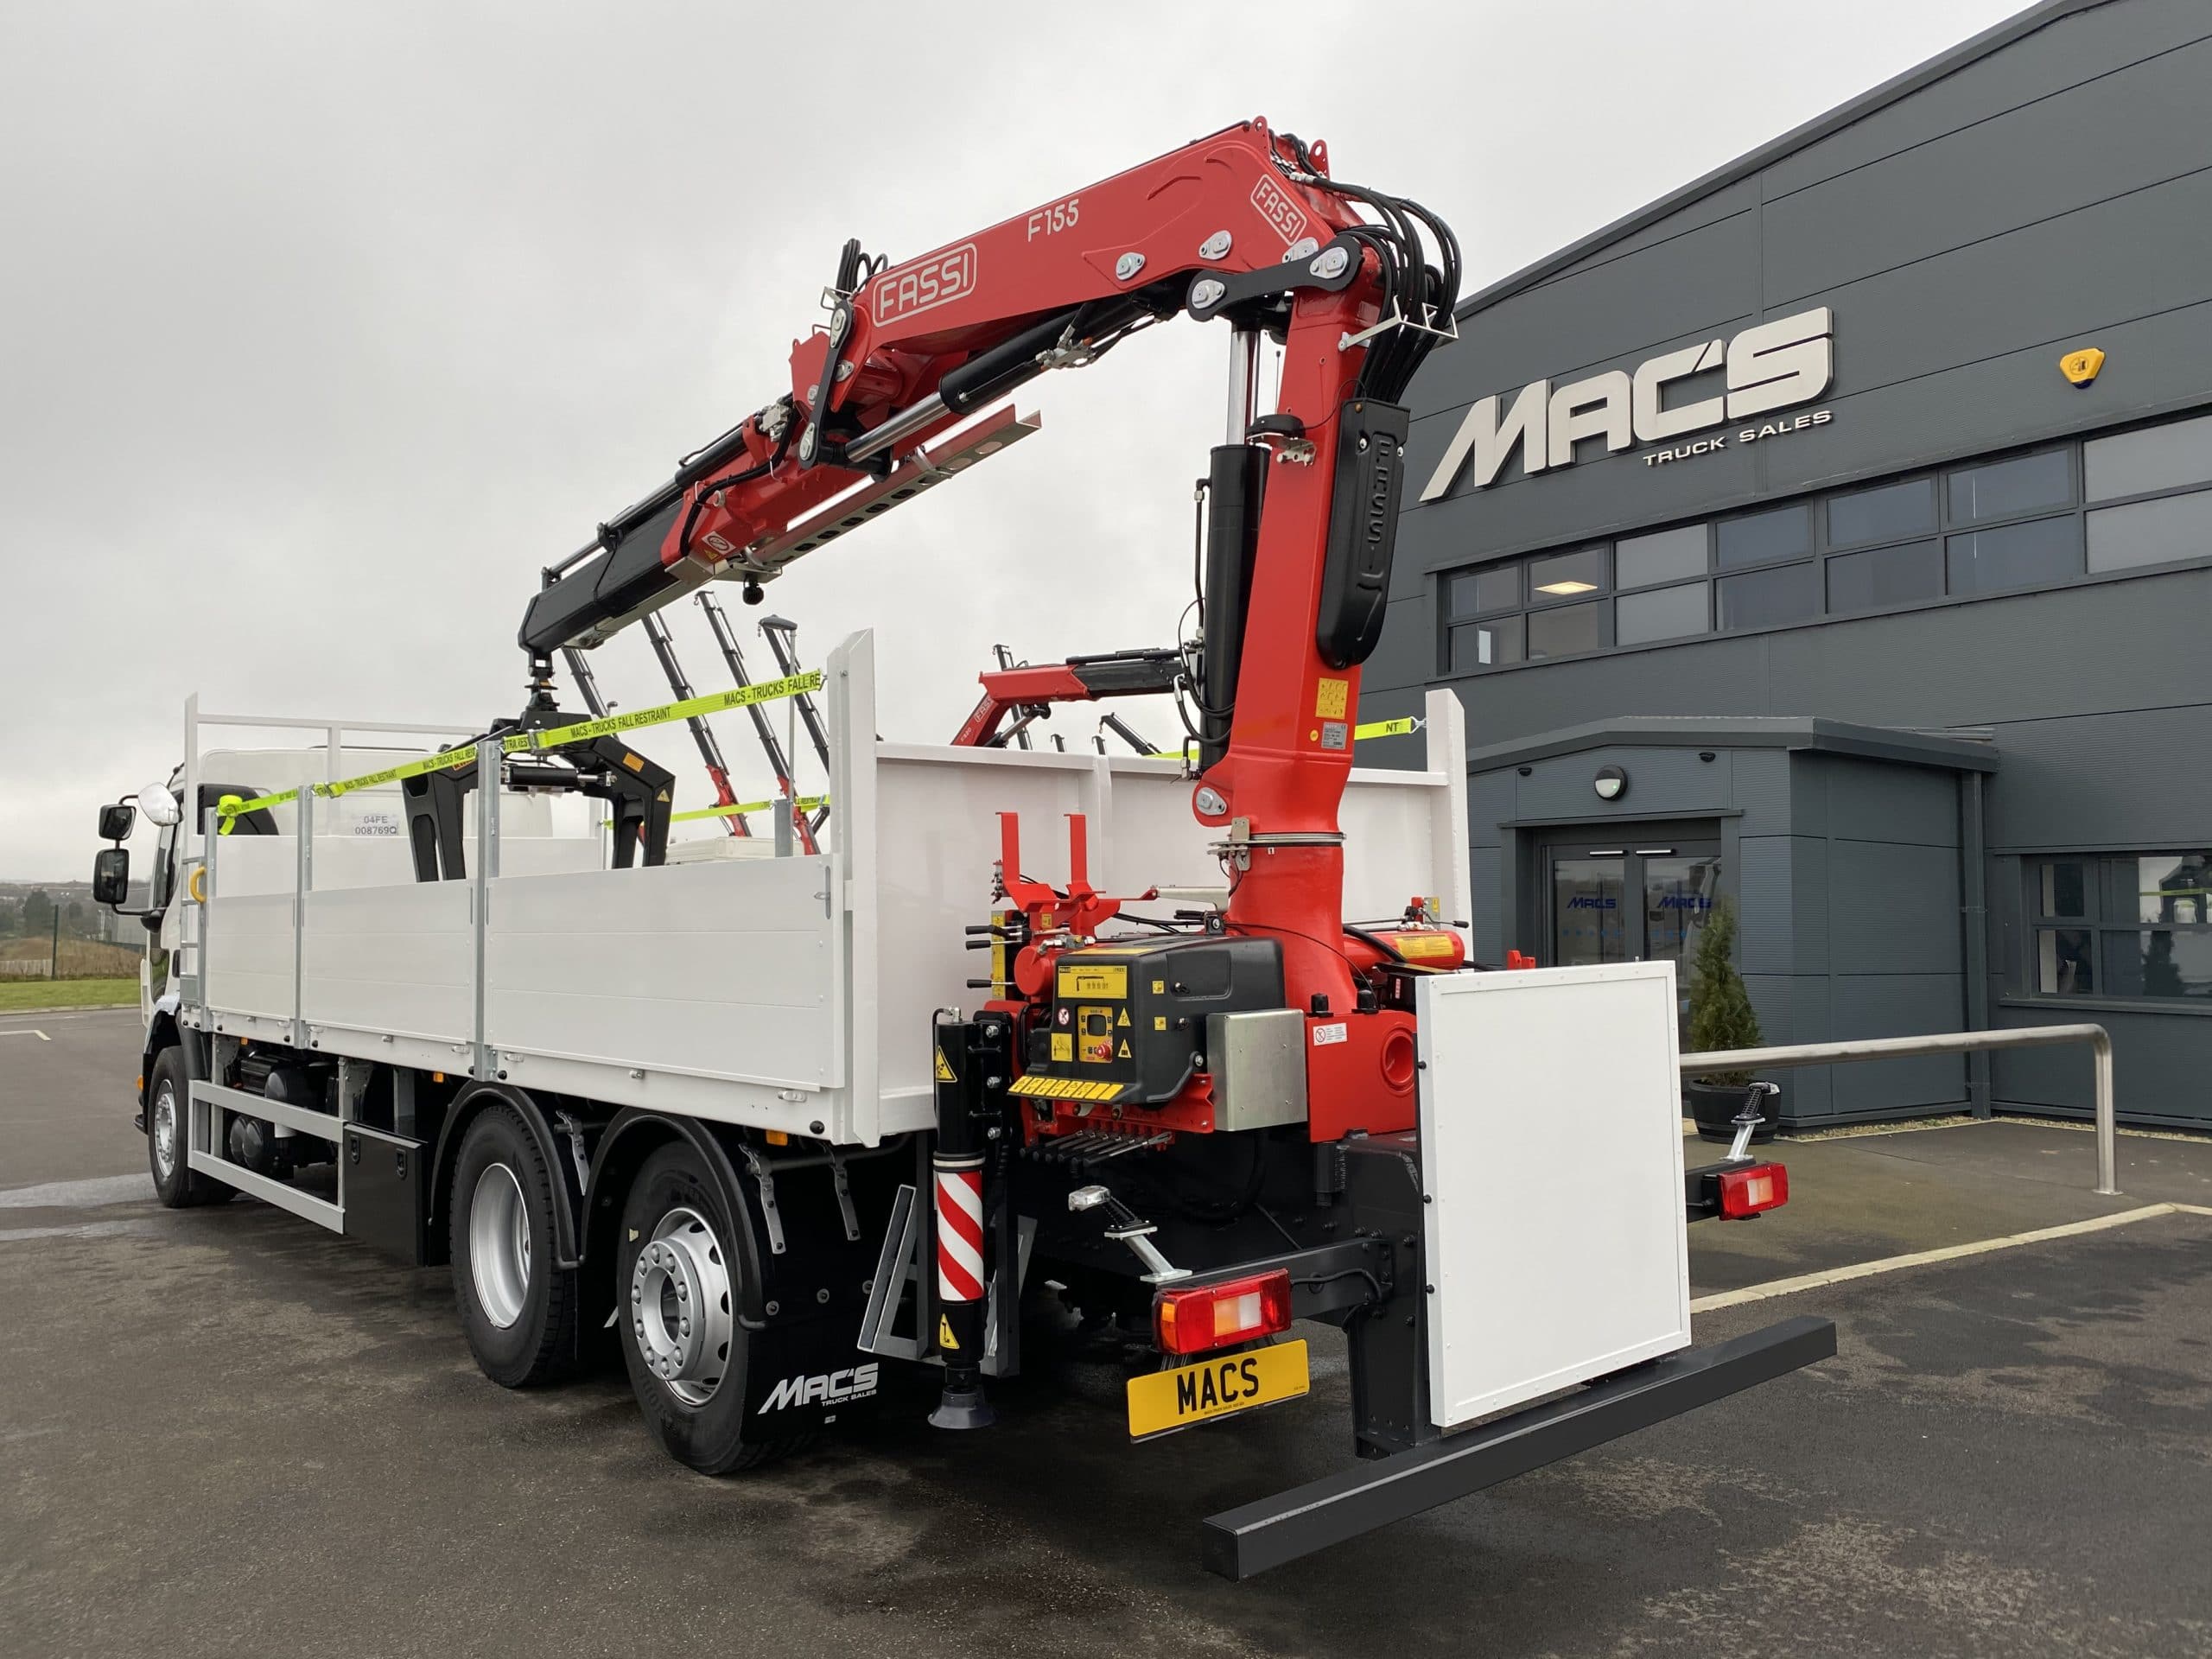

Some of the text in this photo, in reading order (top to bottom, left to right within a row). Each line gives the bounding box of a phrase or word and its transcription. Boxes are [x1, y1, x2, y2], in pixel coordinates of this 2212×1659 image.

[1027, 198, 1079, 243] F155
[1256, 182, 1301, 238] FASSI
[880, 252, 969, 319] FASSI
[1643, 410, 1833, 467] TRUCK SALES
[724, 690, 746, 706] MACS
[752, 681, 785, 700] TRUCKS
[788, 677, 808, 692] FALL
[570, 725, 588, 739] MACS
[591, 718, 616, 734] TRUCKS
[618, 716, 634, 729] FALL
[635, 707, 671, 728] RESTRAINT
[1385, 722, 1399, 733] NT
[363, 816, 388, 824] 04FE
[822, 1389, 877, 1407] TRUCK SALES
[1177, 1357, 1259, 1415] MACS
